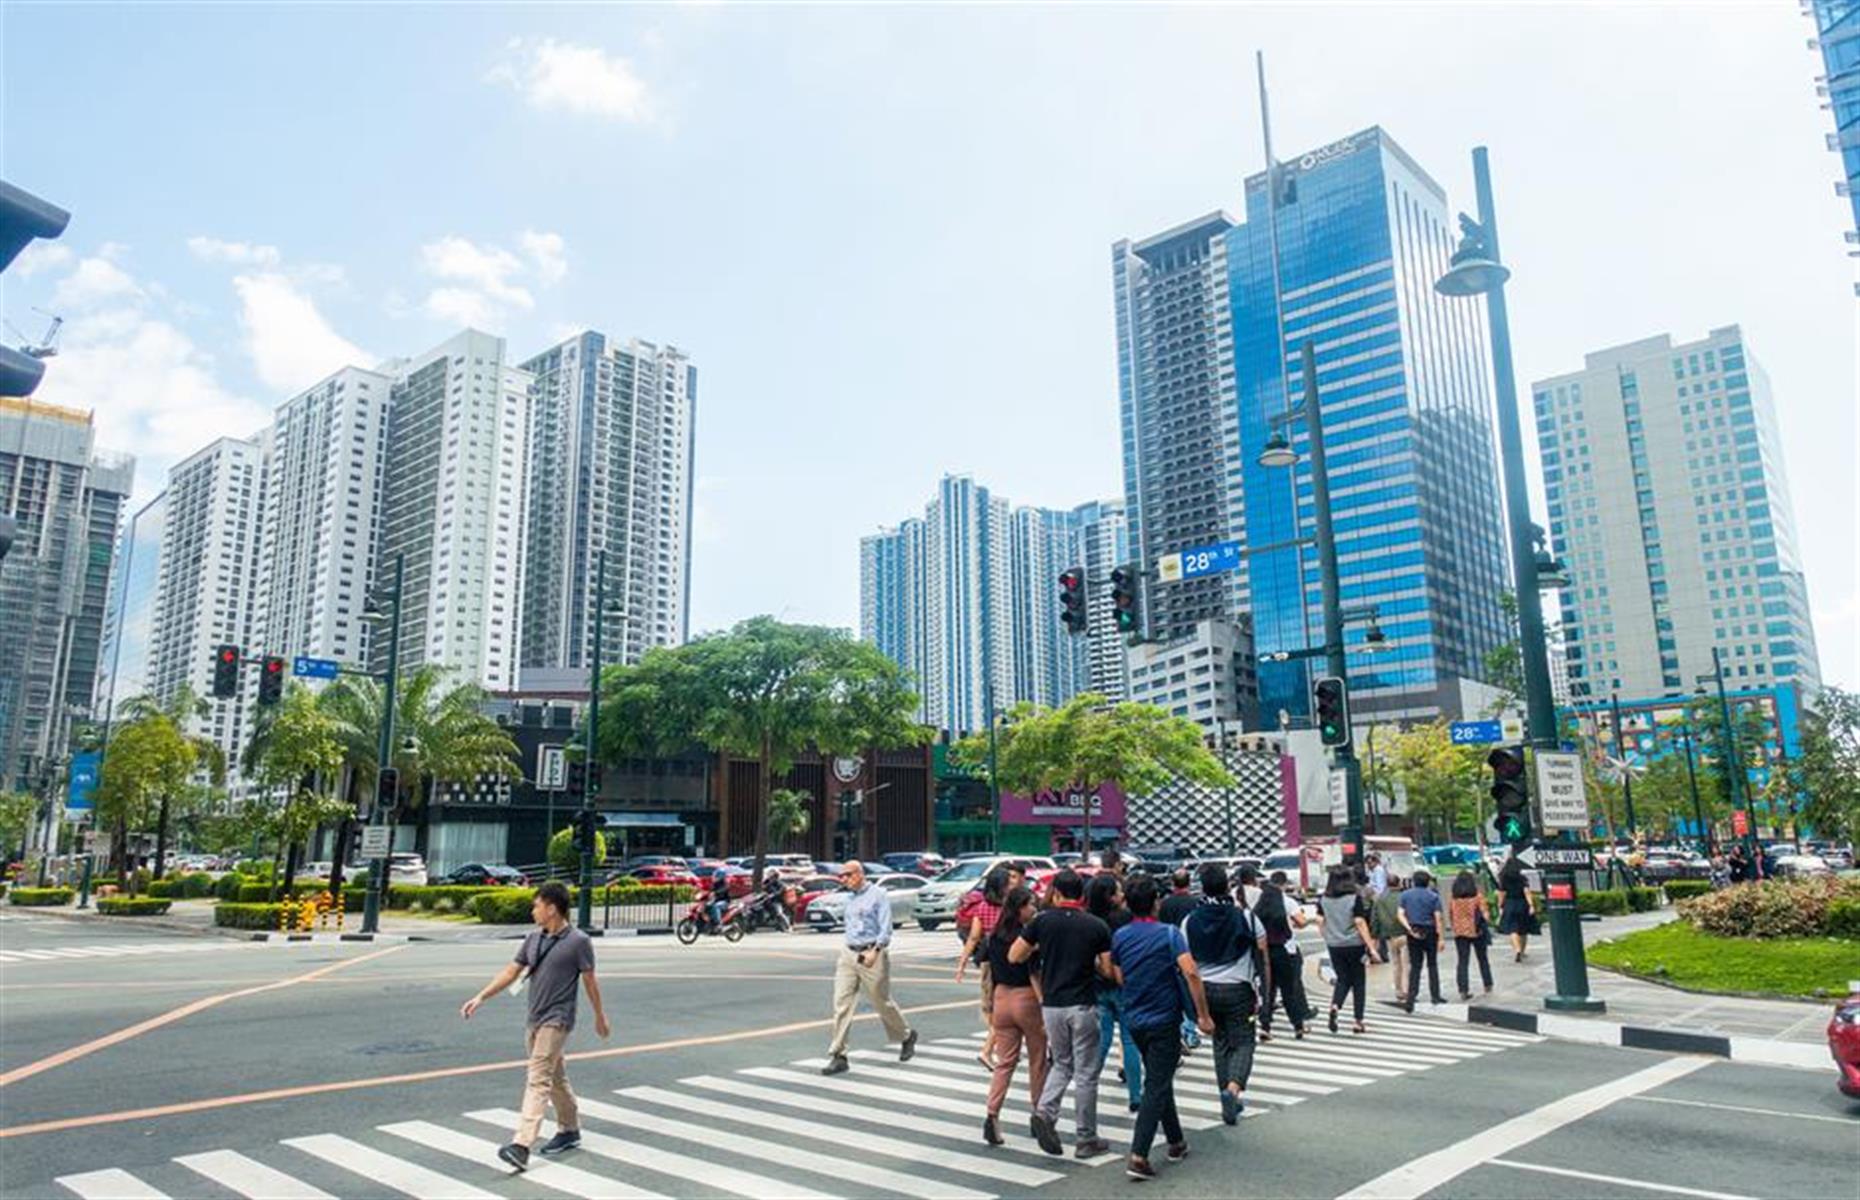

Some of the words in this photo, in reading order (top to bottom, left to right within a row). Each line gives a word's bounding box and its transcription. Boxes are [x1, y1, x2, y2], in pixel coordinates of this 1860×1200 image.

[1548, 771, 1573, 780] TRAFFIC
[1551, 785, 1573, 795] MUST
[1535, 850, 1560, 863] ONE
[1562, 850, 1588, 863] WAY
